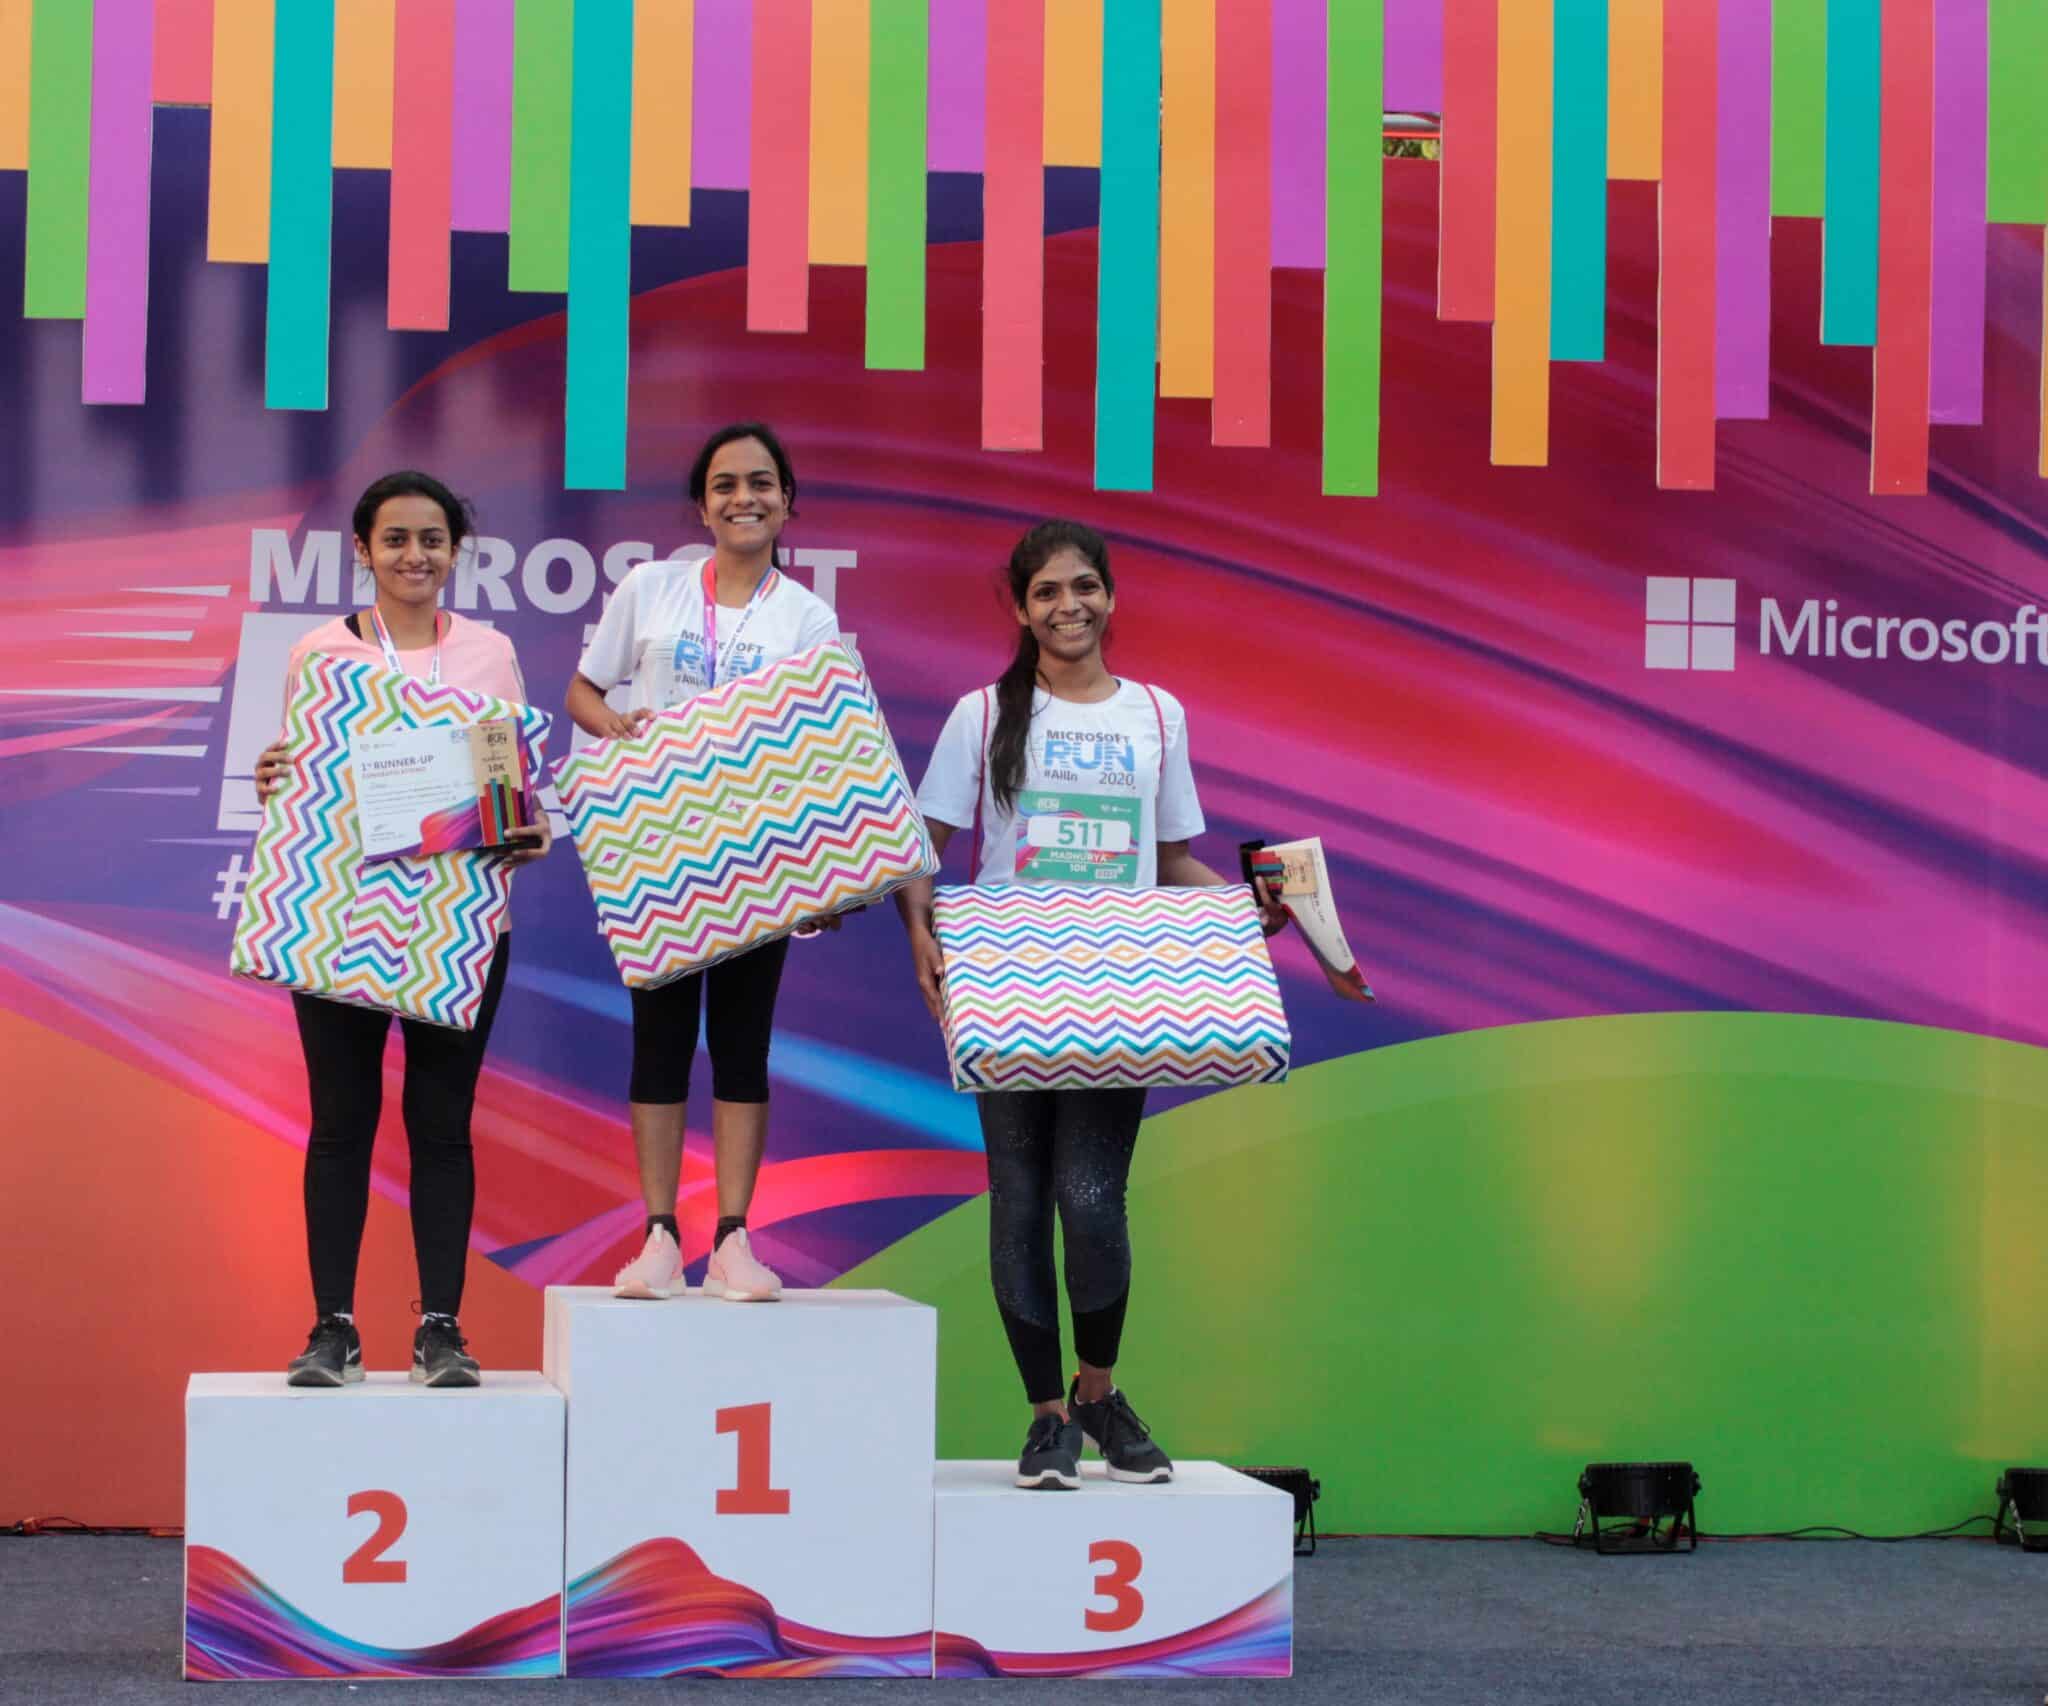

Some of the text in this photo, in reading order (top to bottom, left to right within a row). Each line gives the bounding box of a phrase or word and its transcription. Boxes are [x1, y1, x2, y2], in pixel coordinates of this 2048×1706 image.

[1759, 597, 2048, 667] Microsoft
[1046, 729, 1130, 745] MICROSOFT
[374, 754, 435, 770] RUNNER-UP
[1043, 740, 1137, 772] RUN
[1098, 771, 1135, 787] 2020
[1057, 819, 1104, 848] 511
[1049, 850, 1108, 863] MADHURYA
[1069, 863, 1088, 873] 10K
[716, 1403, 790, 1514] 1
[343, 1490, 408, 1583] 2
[1085, 1540, 1144, 1632] 3
